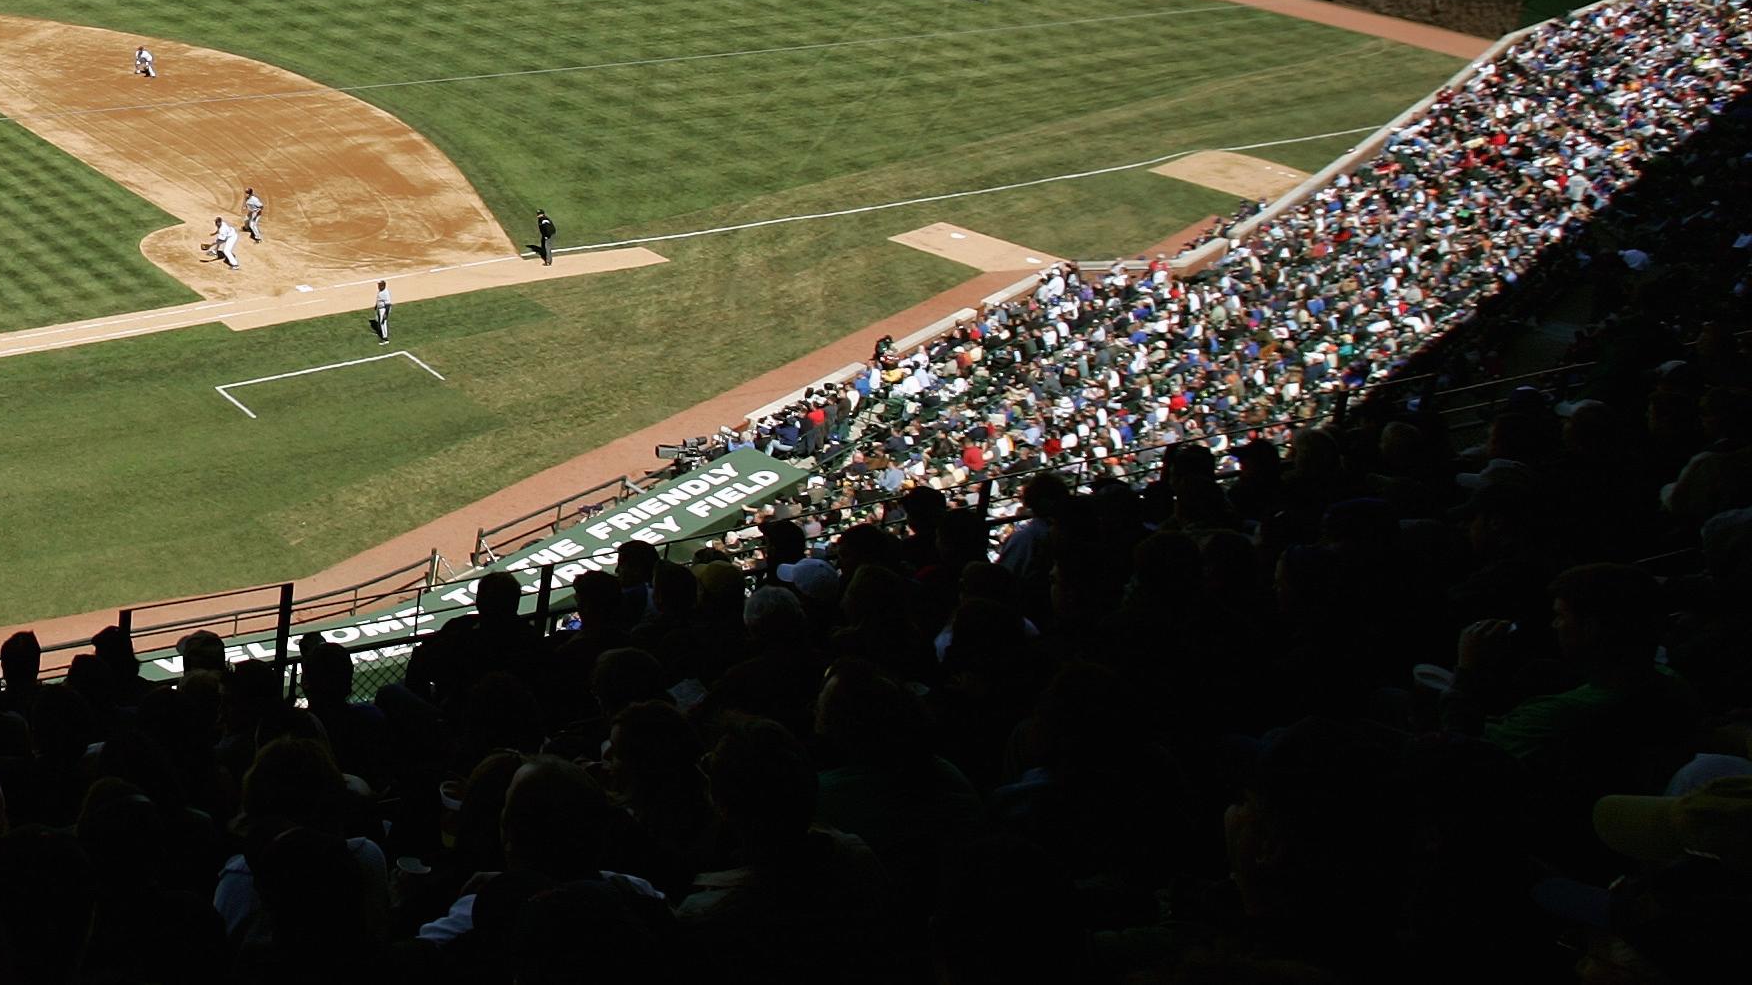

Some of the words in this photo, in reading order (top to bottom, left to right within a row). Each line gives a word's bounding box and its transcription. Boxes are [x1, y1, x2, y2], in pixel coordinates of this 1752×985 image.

[506, 538, 586, 576] THE
[586, 462, 739, 540] FRIENDLY
[686, 470, 780, 518] FIELD
